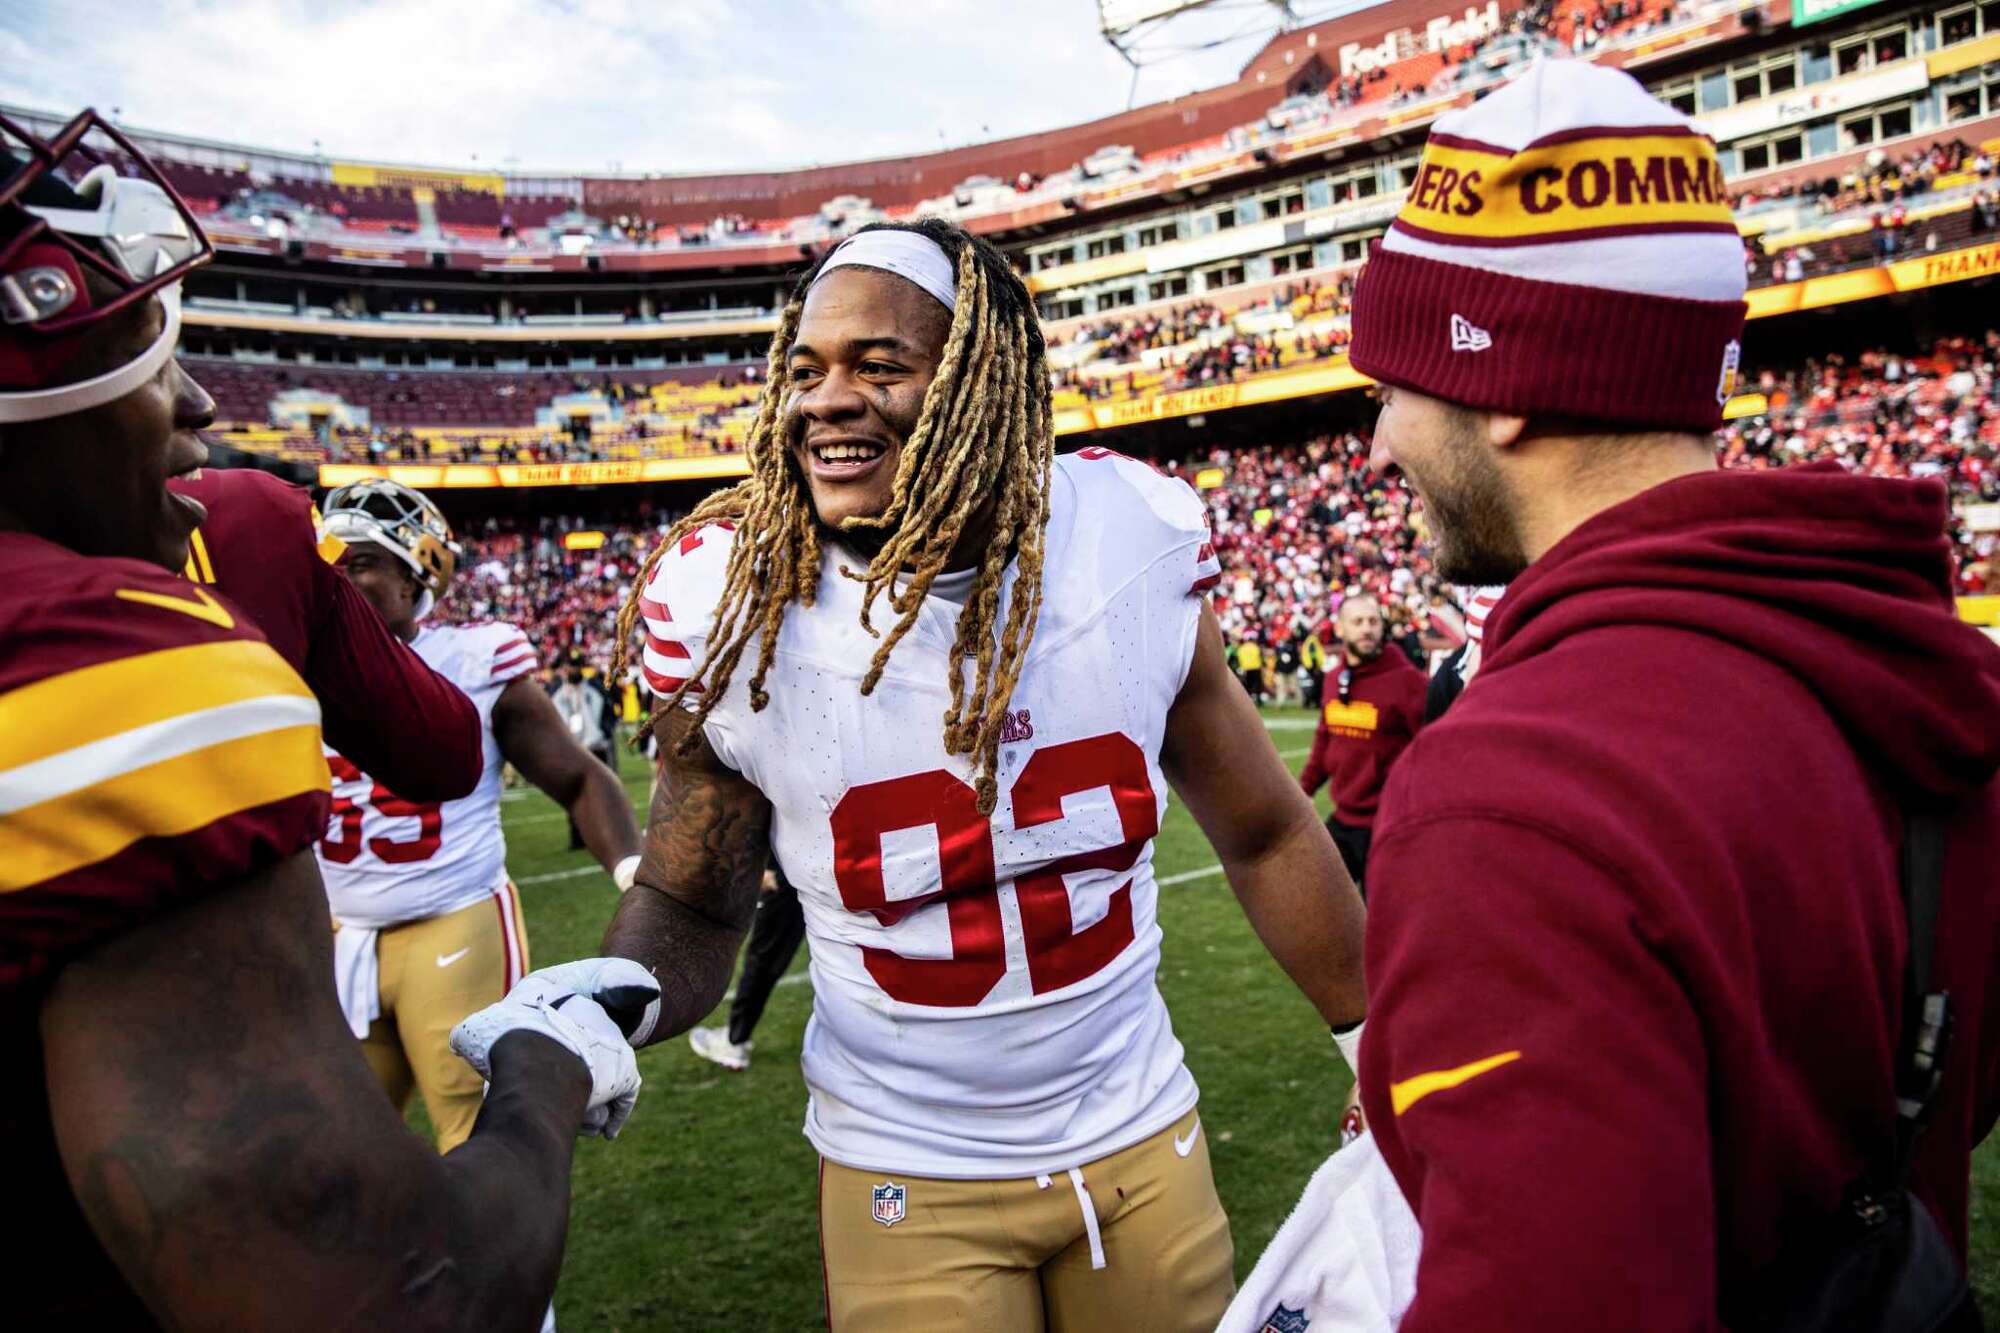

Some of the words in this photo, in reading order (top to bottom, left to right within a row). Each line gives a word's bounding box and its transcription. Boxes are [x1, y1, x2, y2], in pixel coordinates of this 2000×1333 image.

[1407, 163, 1484, 216] ERS
[829, 732, 1158, 1007] 92
[877, 1200, 900, 1217] NFL
